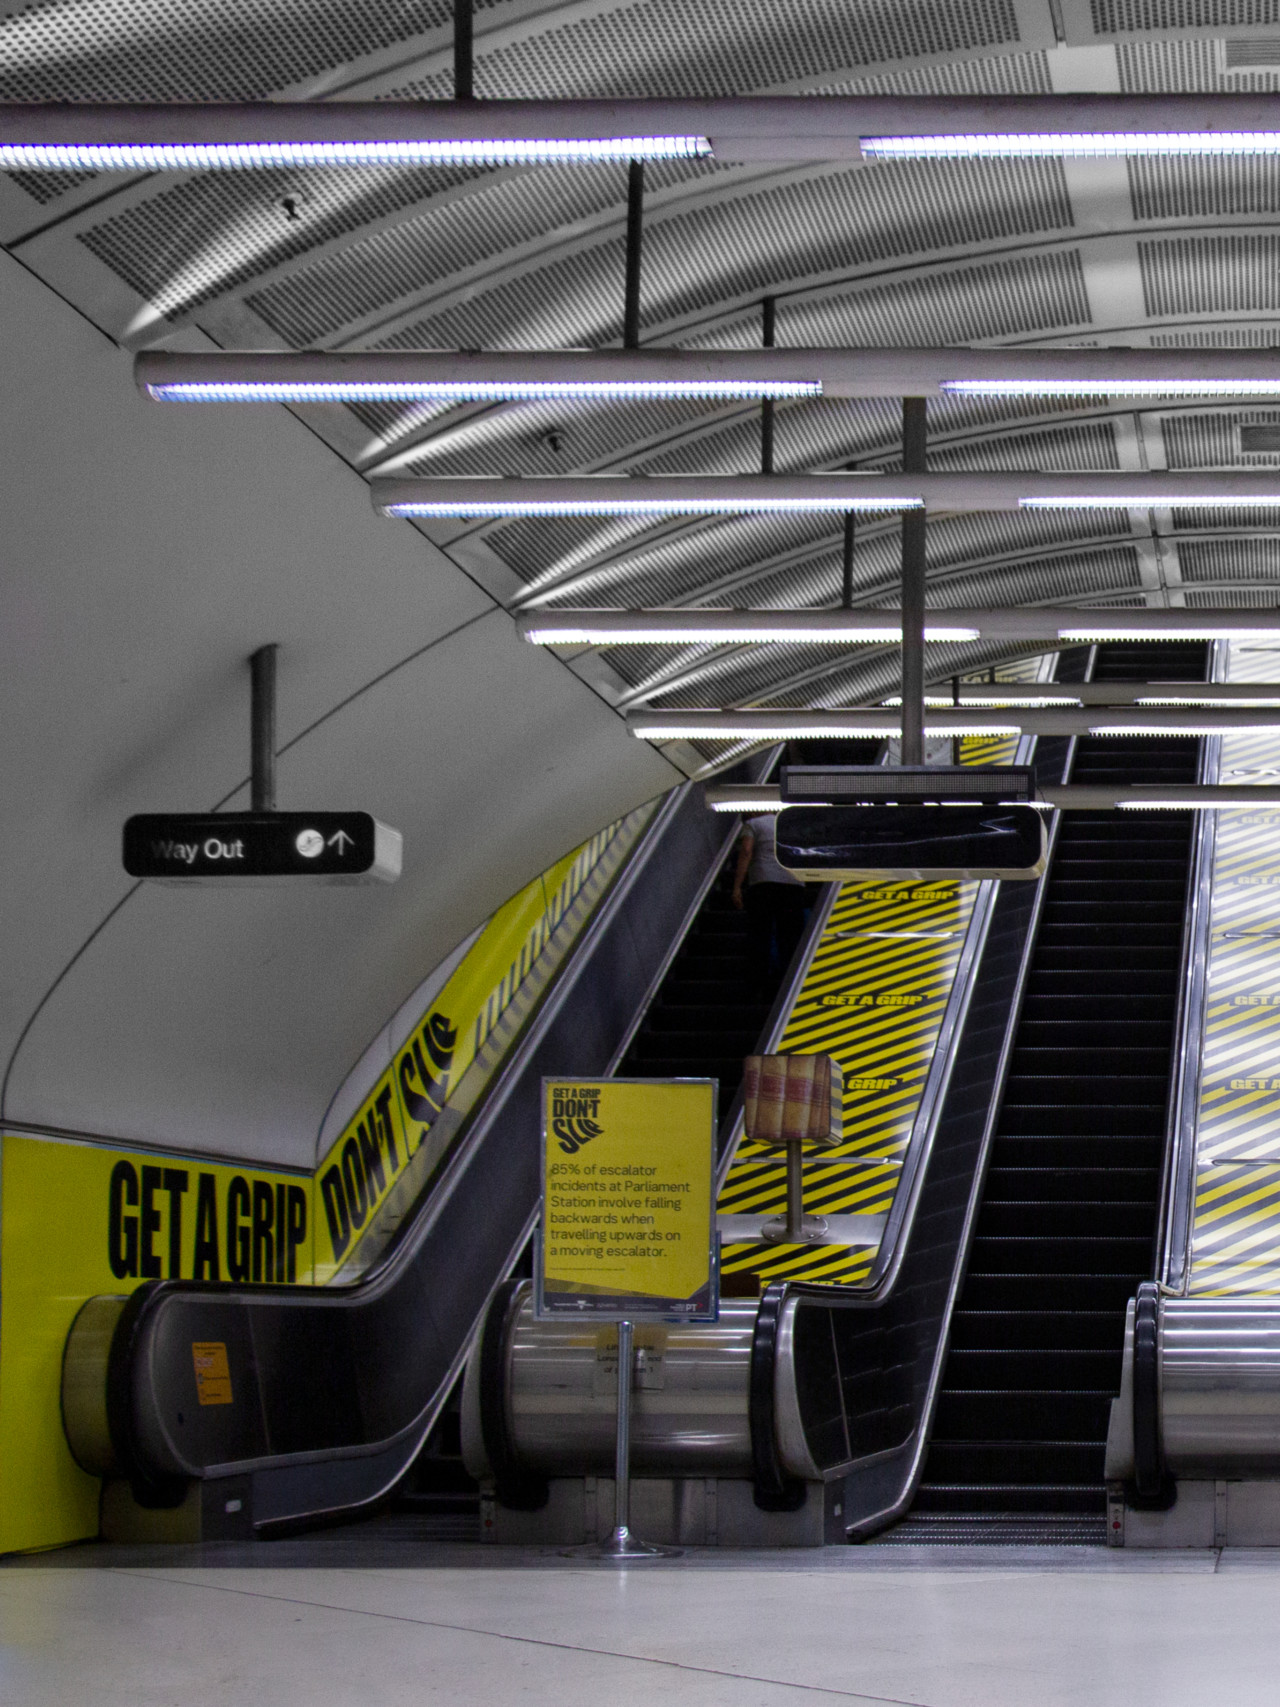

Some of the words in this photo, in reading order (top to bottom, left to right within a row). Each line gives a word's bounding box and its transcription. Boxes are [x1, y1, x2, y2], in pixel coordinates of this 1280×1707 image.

[151, 839, 198, 864] Way
[204, 838, 244, 859] Out
[1238, 876, 1270, 885] GET
[861, 890, 897, 900] GET
[896, 890, 910, 900] A
[910, 890, 954, 900] GRIP
[822, 995, 861, 1005] GET
[859, 995, 874, 1005] A
[875, 995, 923, 1005] GRIP
[1234, 995, 1271, 1005] GET
[846, 1078, 898, 1090] GRIP
[1230, 1078, 1269, 1090] GET
[552, 1087, 571, 1100] GET
[571, 1087, 578, 1100] A
[579, 1087, 601, 1100] GRIP
[552, 1100, 601, 1118] DON'T
[320, 1083, 400, 1263] DON'T
[399, 1012, 459, 1147] SLIP
[552, 1118, 605, 1155] SLIP
[551, 1163, 581, 1176] 85%
[583, 1163, 597, 1176] of
[599, 1164, 657, 1176] escalator
[551, 1180, 606, 1192] incidents
[609, 1181, 622, 1192] at
[624, 1180, 691, 1193] Parliament
[550, 1195, 596, 1208] Station
[598, 1196, 642, 1208] involve
[645, 1196, 682, 1212] falling
[107, 1159, 189, 1280] GET
[192, 1172, 220, 1281] A
[226, 1175, 307, 1283] GRIP
[550, 1212, 618, 1224] backwards
[621, 1213, 655, 1225] when
[550, 1228, 607, 1243] travelling
[609, 1229, 663, 1243] upwards
[665, 1231, 681, 1241] on
[550, 1247, 558, 1256] a
[559, 1245, 604, 1259] moving
[606, 1245, 668, 1257] escalator.
